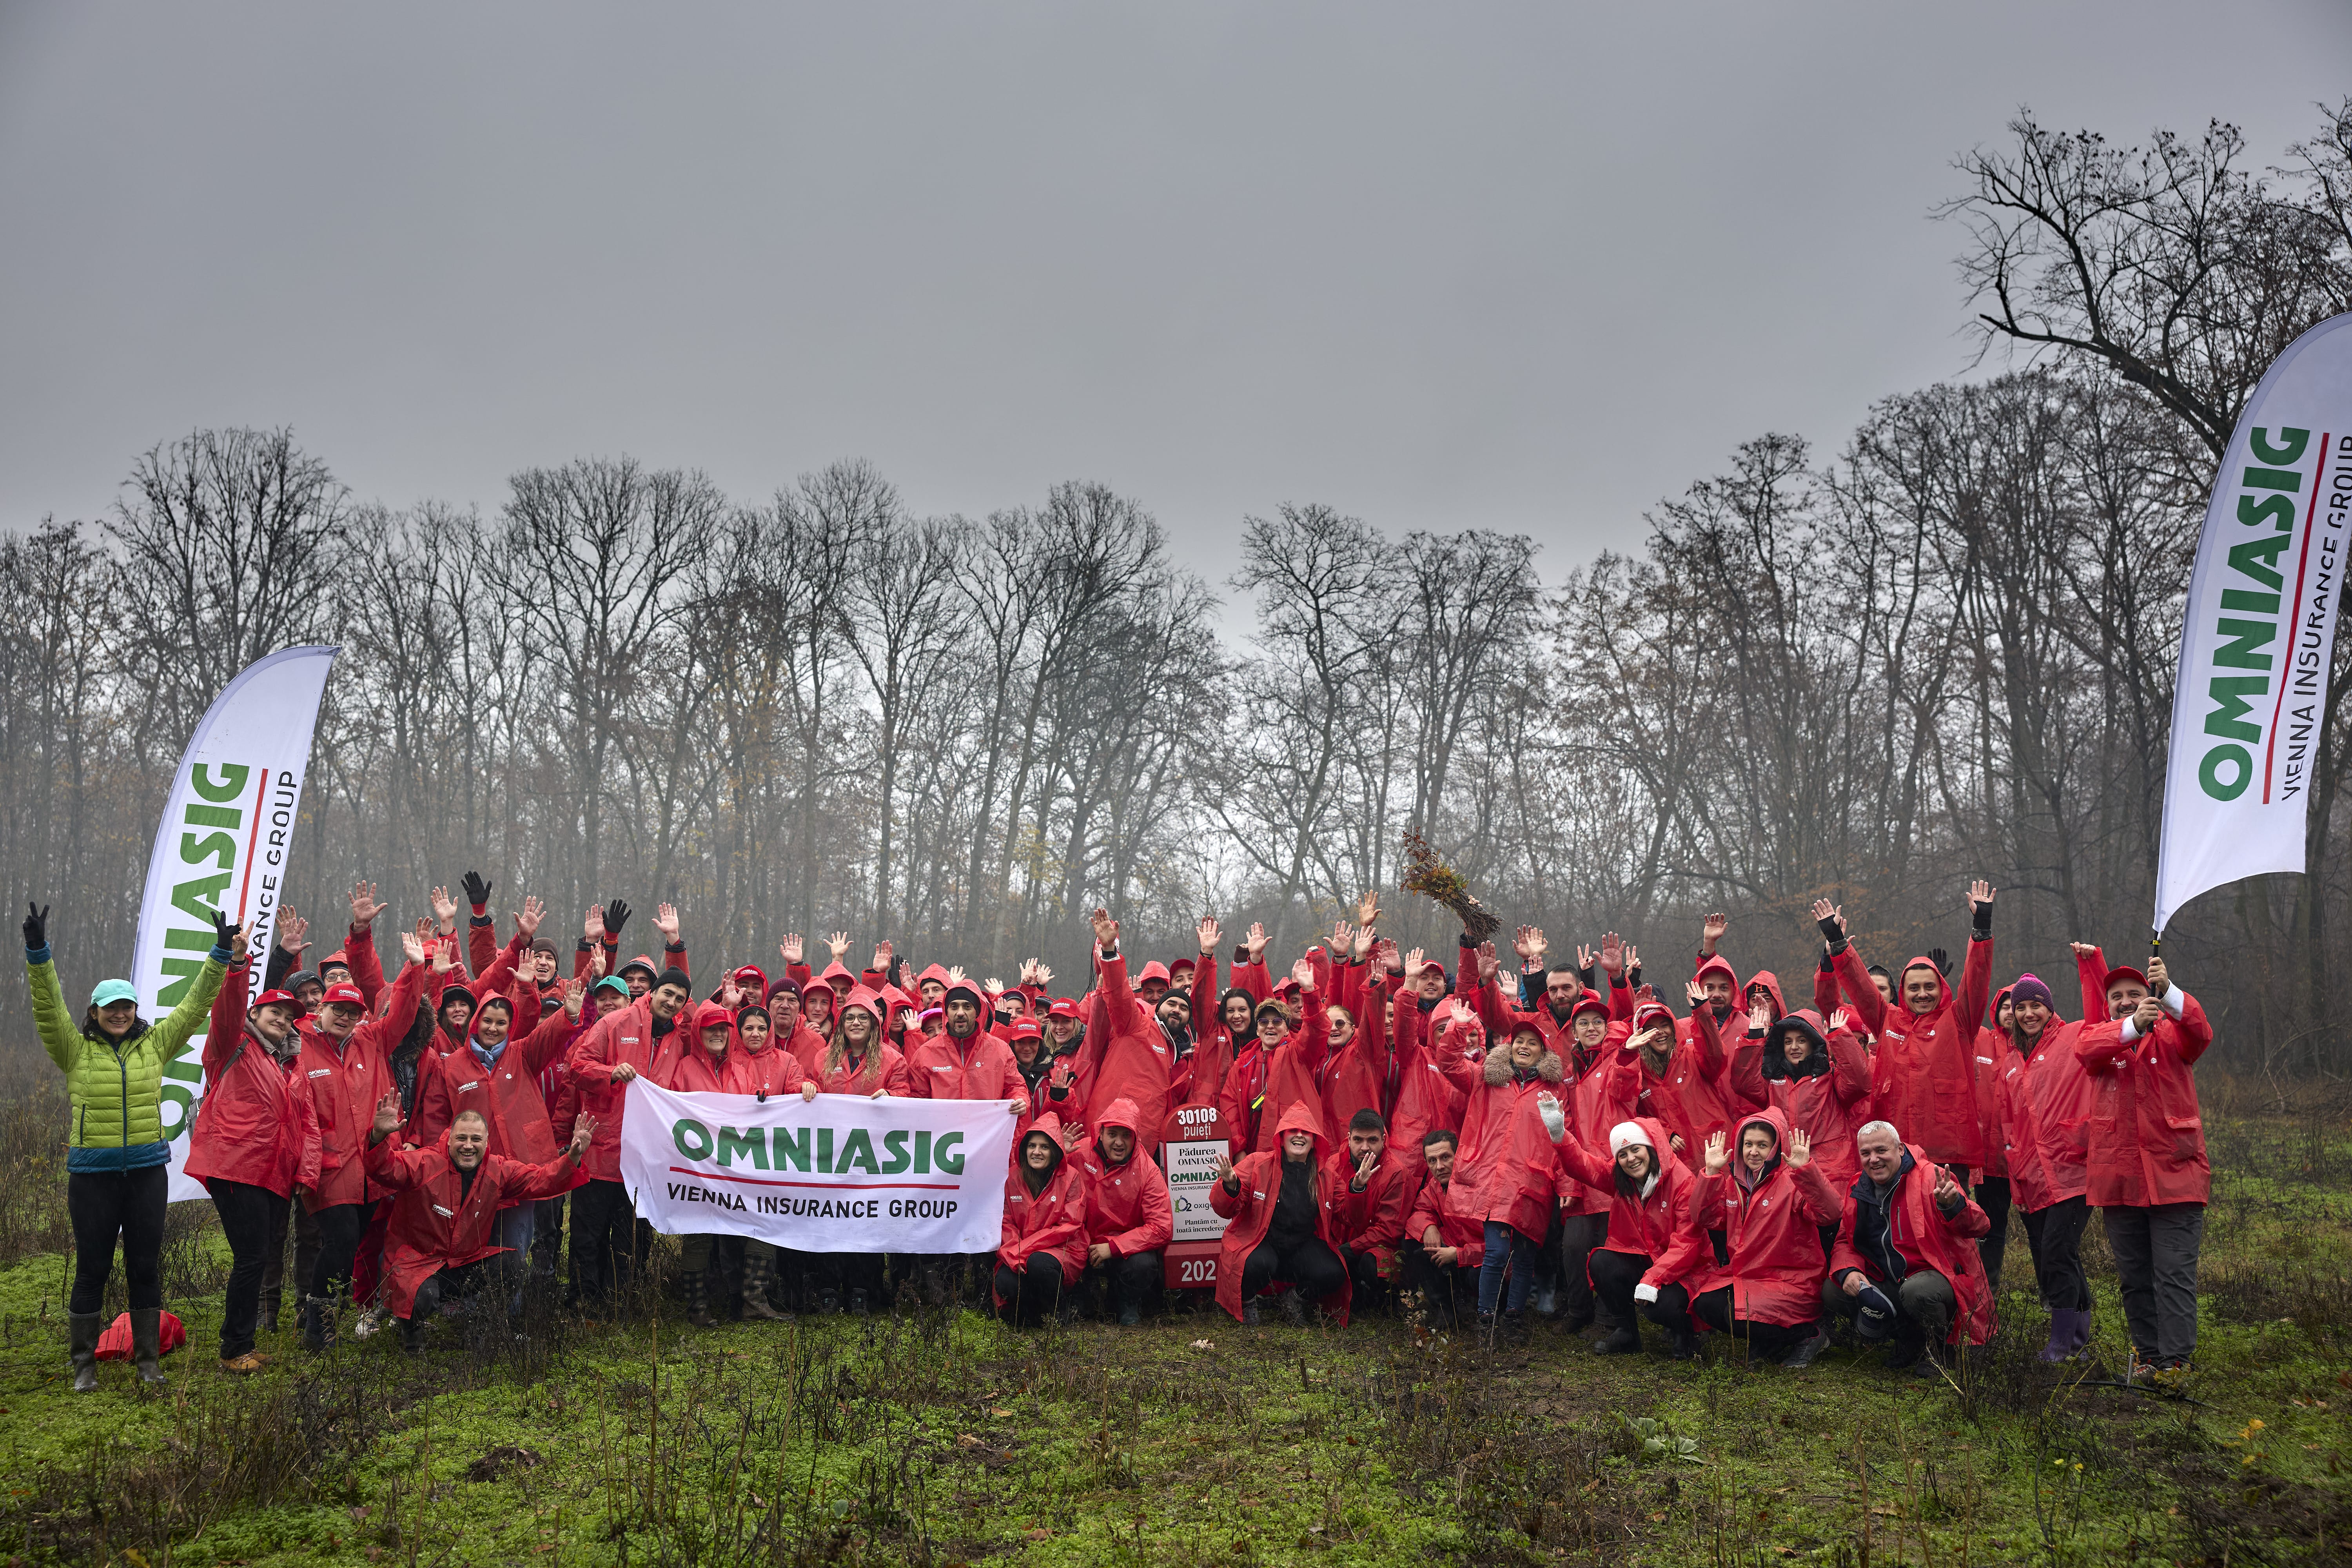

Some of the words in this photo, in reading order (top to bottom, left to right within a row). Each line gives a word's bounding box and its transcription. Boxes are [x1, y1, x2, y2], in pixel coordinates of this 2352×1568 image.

[2198, 426, 2310, 802] OMNIASIG
[2293, 537, 2337, 695] INSURANCE
[2281, 705, 2315, 801] VIENNA
[267, 771, 297, 866] GROUP
[339, 989, 359, 998] OMNIASIG
[458, 1081, 478, 1091] OMNIASIG
[1178, 1107, 1217, 1125] 30108
[1184, 1122, 1211, 1140] puieți
[672, 1119, 965, 1175] OMNIASIG
[1179, 1147, 1216, 1156] Pădurea
[1178, 1157, 1218, 1166] OMNIASIG
[1171, 1171, 1220, 1183] OMNIAS
[667, 1182, 747, 1212] VIENNA
[757, 1196, 878, 1218] INSURANCE
[889, 1199, 958, 1218] GROUP
[1861, 1306, 1885, 1319] Ford
